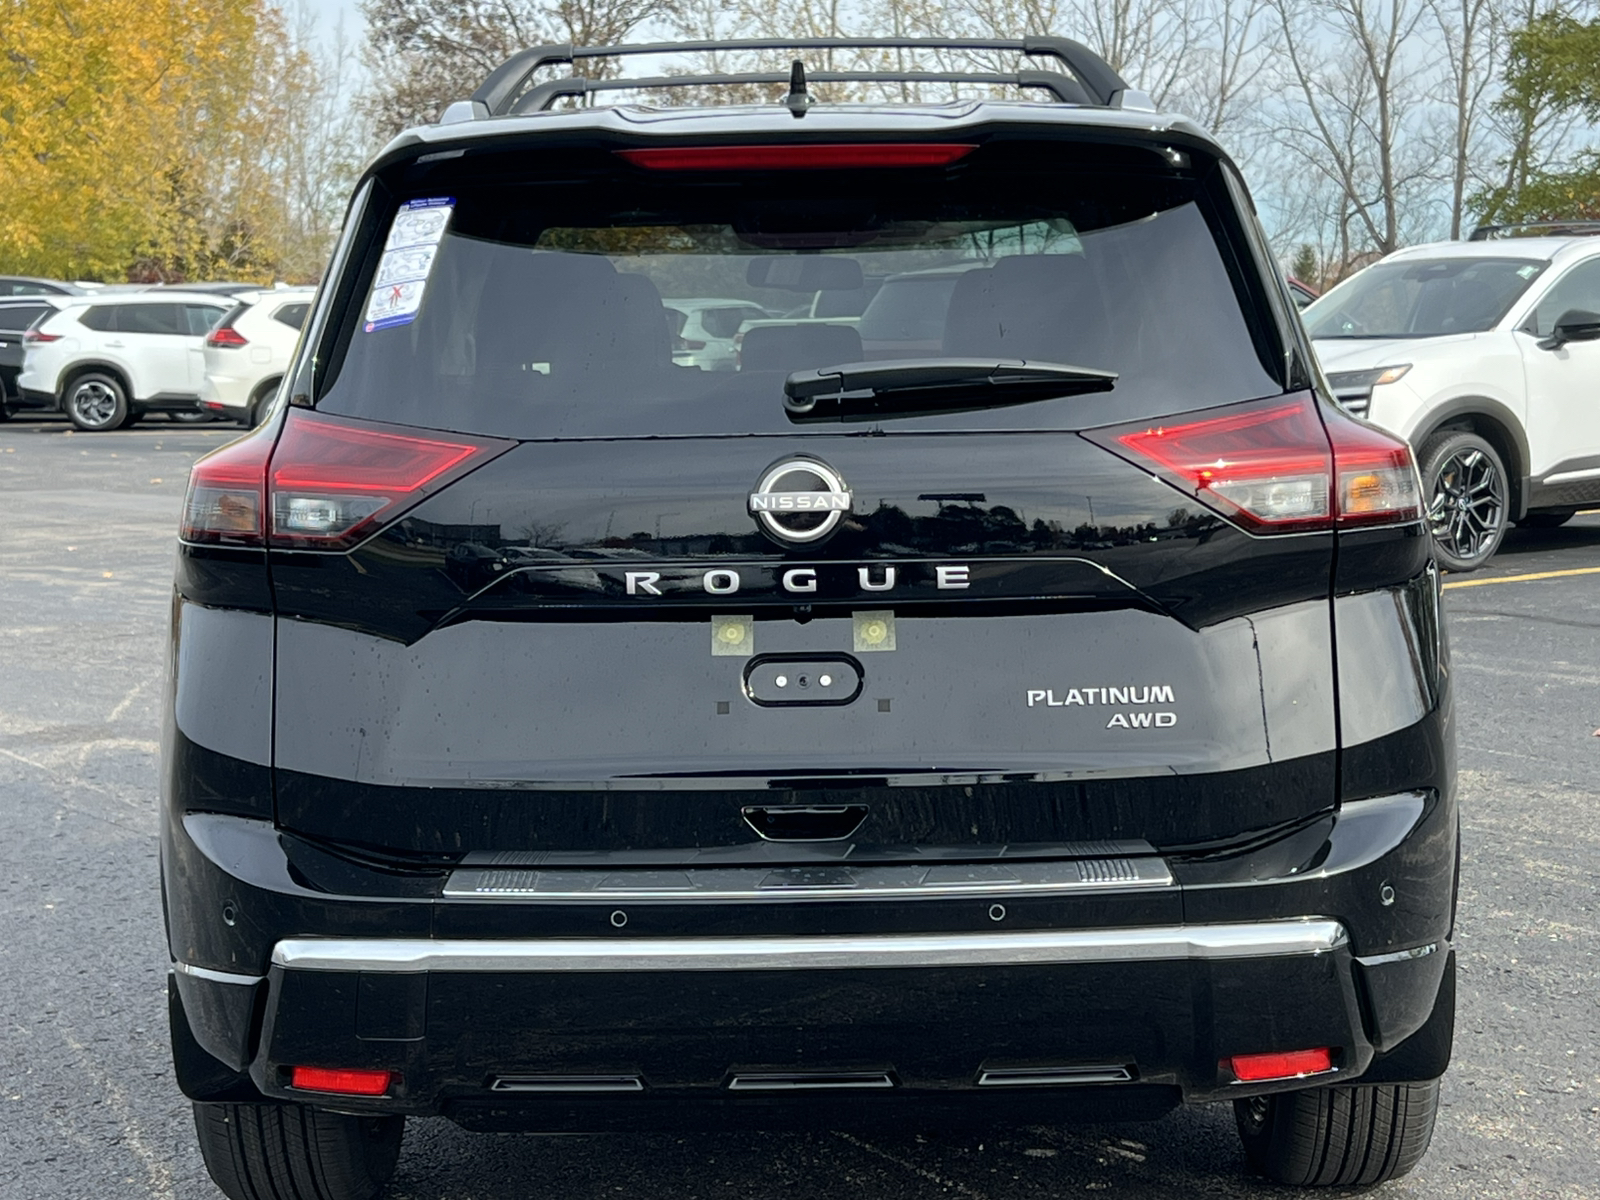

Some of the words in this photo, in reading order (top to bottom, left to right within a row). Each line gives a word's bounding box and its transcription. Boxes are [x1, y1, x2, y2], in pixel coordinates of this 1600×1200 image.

[752, 496, 847, 509] NISSAN
[625, 566, 971, 596] ROGUE
[1027, 685, 1175, 707] PLATINUM
[1106, 712, 1177, 729] AWD
